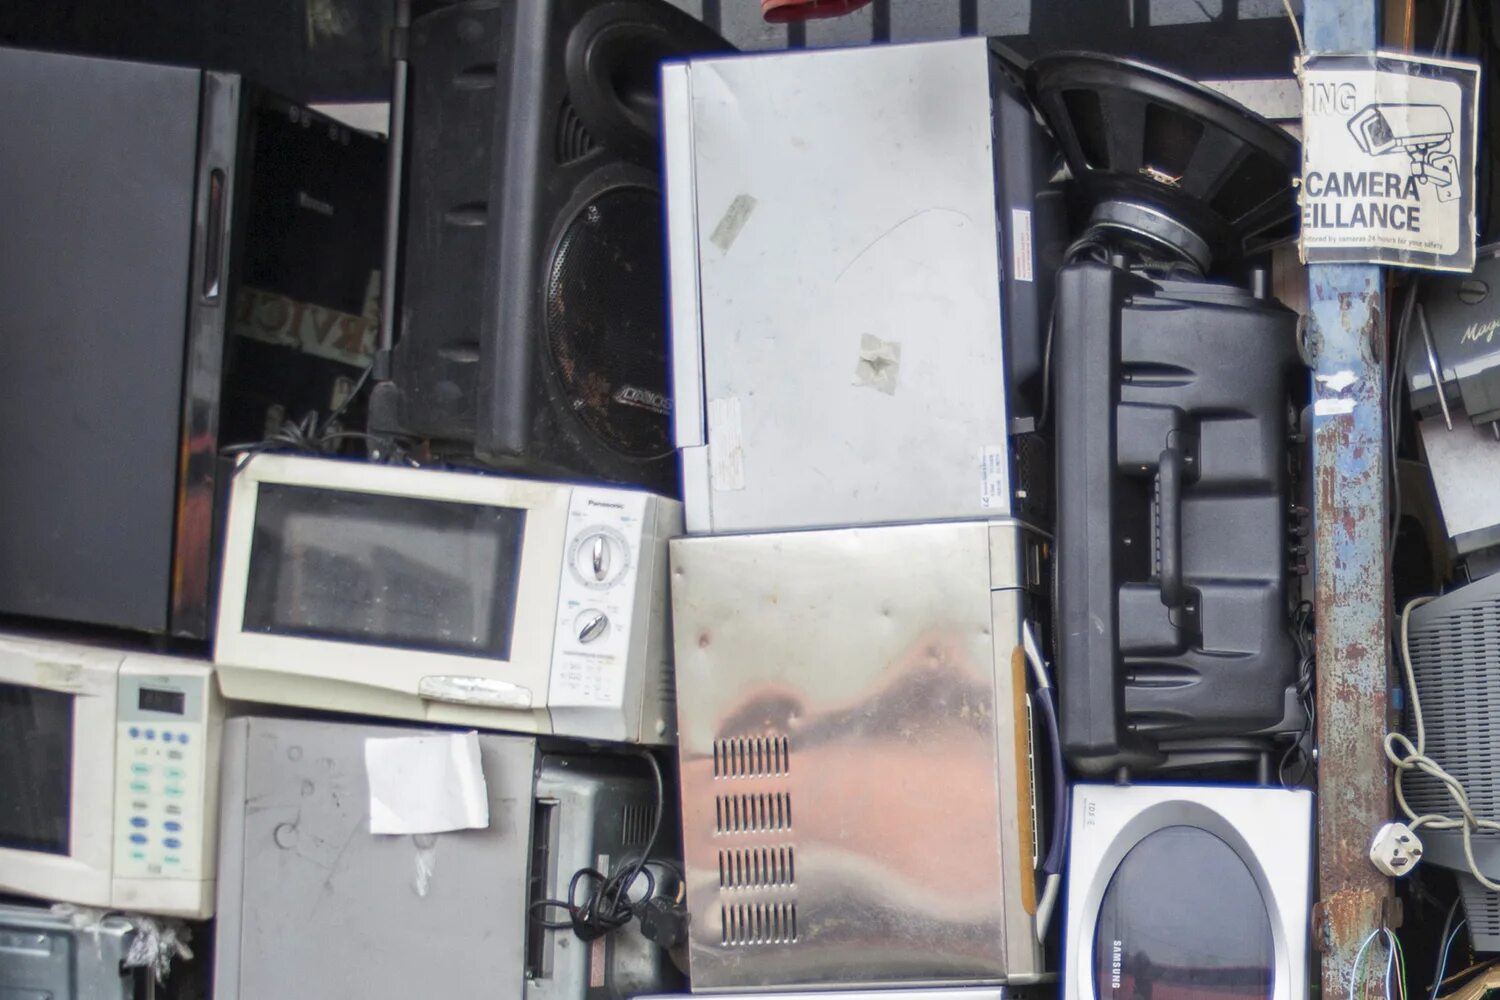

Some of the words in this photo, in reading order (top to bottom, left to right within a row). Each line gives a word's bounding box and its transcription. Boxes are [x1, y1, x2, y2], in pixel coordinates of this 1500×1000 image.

[1305, 170, 1421, 202] CAMERA
[587, 500, 625, 510] Panasonic
[1112, 940, 1122, 989] SAMSUNG
